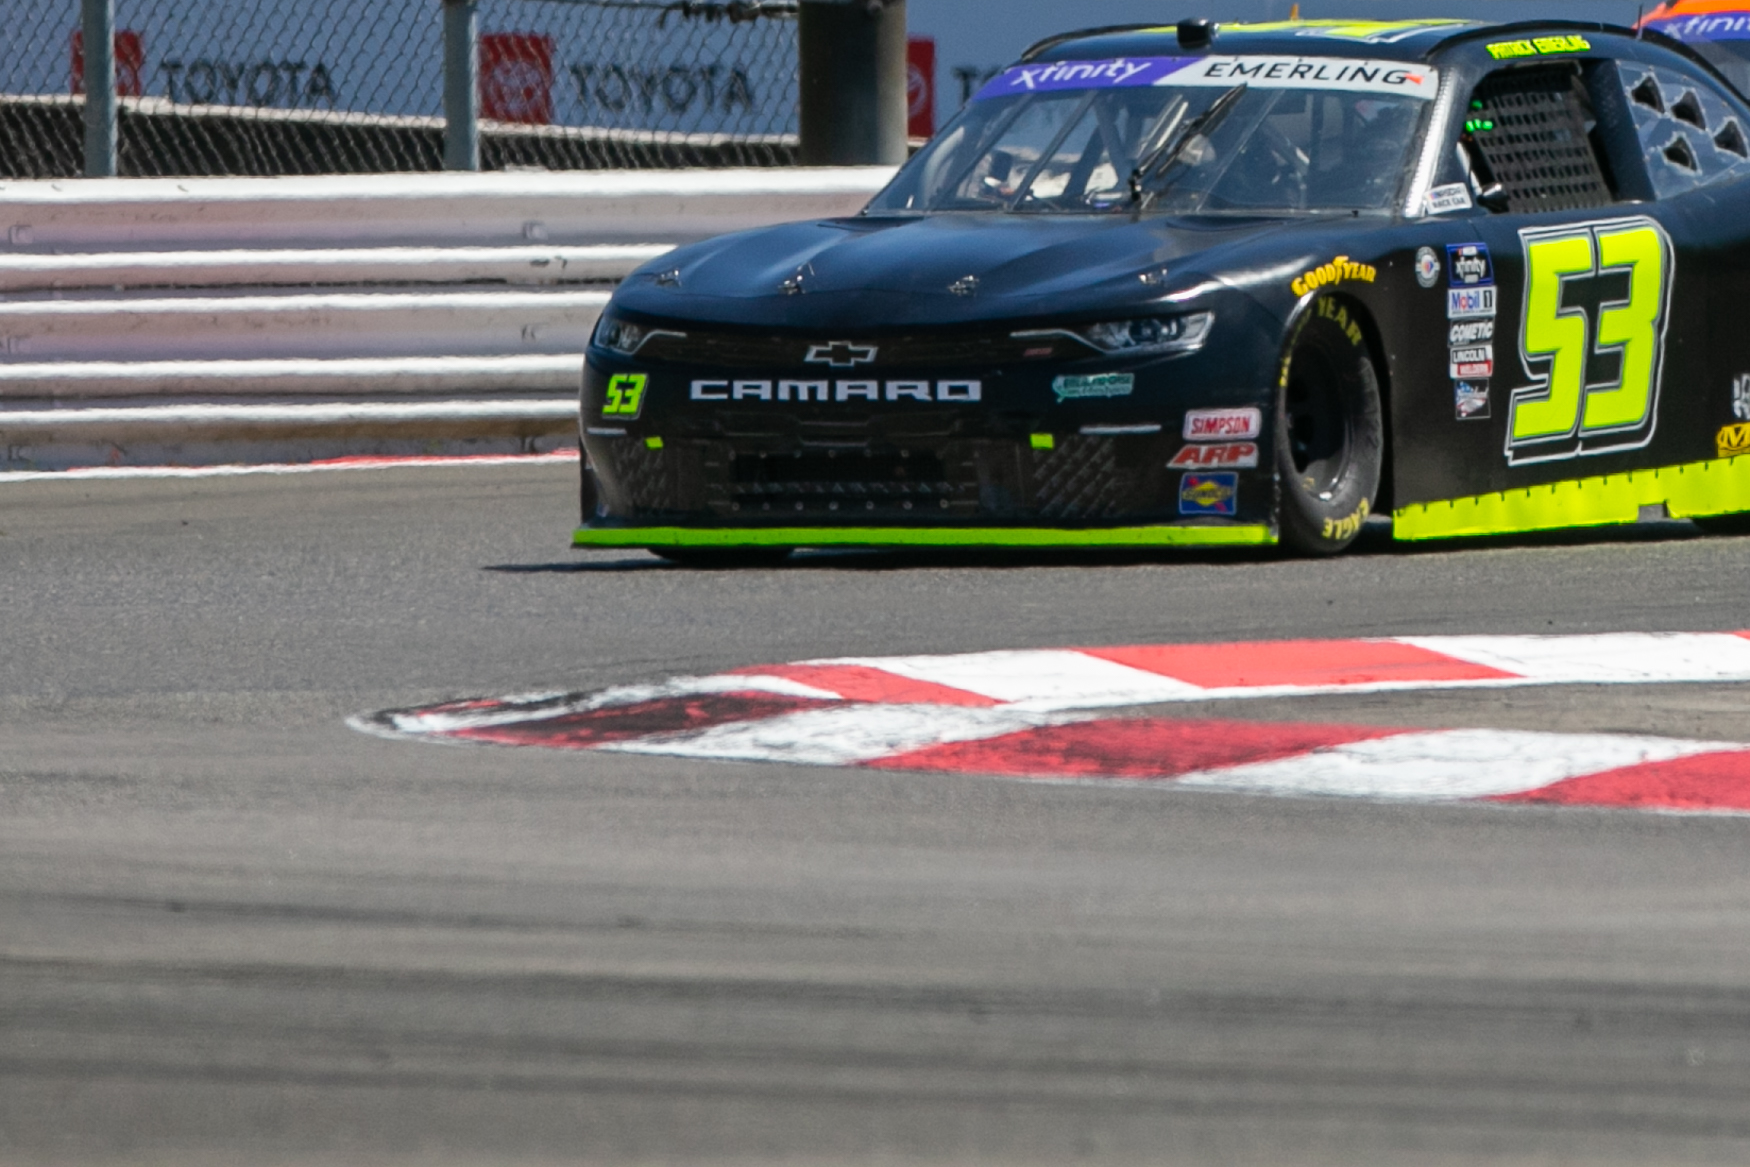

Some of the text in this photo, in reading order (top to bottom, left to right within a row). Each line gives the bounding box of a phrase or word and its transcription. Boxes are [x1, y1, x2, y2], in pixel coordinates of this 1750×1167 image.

[159, 60, 335, 107] TOYOTA
[1010, 61, 1152, 89] xfinity
[1203, 62, 1407, 85] EMERLING
[570, 64, 753, 114] TOYOTA
[1290, 255, 1377, 297] GOODYEAR
[1451, 290, 1480, 311] Mobil
[1508, 220, 1670, 452] 53
[1453, 349, 1486, 363] LINCOLN
[602, 374, 648, 416] 53
[690, 379, 982, 402] CAMARO
[1190, 416, 1251, 435] SIMPSON
[1173, 444, 1255, 464] ARP
[1322, 497, 1370, 540] EAGLE
